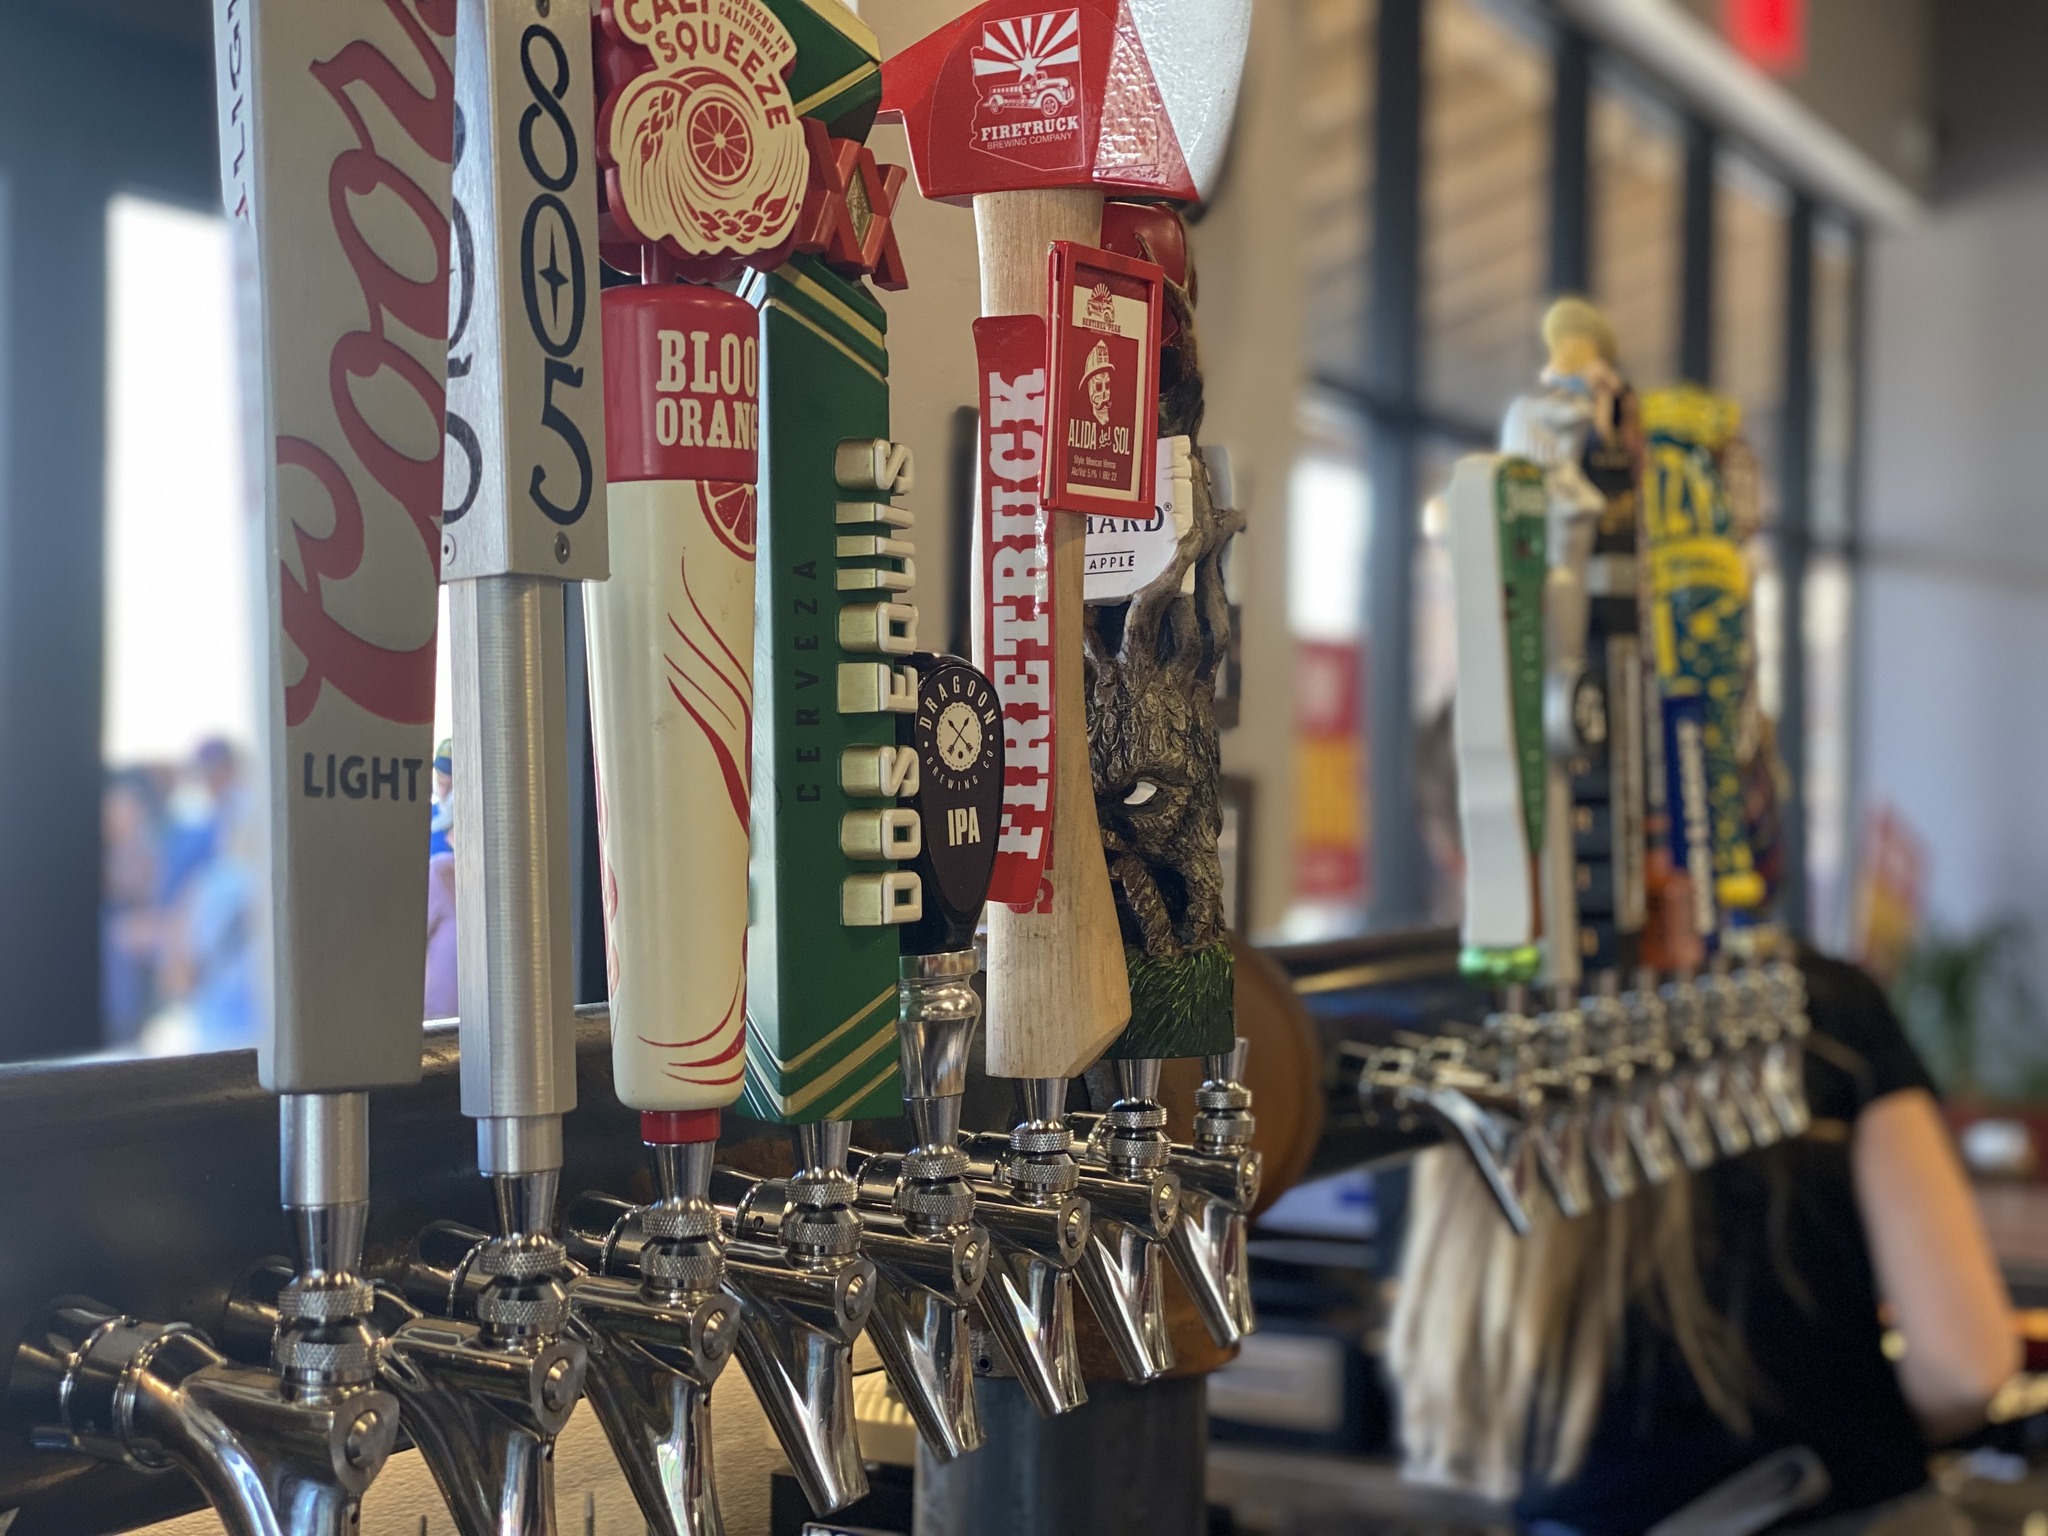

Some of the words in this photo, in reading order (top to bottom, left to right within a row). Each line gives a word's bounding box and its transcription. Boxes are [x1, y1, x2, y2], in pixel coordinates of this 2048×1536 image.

[718, 2, 778, 62] CALIFORNIA
[776, 35, 789, 53] IN
[655, 20, 791, 129] SQUEEZE
[981, 116, 1079, 141] FIRETRUCK
[987, 138, 1027, 150] BREWING
[1029, 132, 1072, 144] COMPANY
[276, 0, 460, 726] Coor
[656, 330, 759, 399] BLOO
[656, 398, 758, 451] ORANG
[1068, 419, 1096, 450] ALIDA
[1098, 426, 1112, 444] del
[1113, 426, 1130, 455] SOL
[1089, 555, 1135, 570] APPLE
[989, 367, 1050, 859] FIRETRUCK
[793, 559, 821, 802] CERVEZA
[919, 675, 996, 731] DRAGOON
[303, 752, 423, 801] LIGHT
[926, 756, 978, 791] BREWING
[860, 745, 922, 925] DOS
[947, 806, 980, 846] IPA
